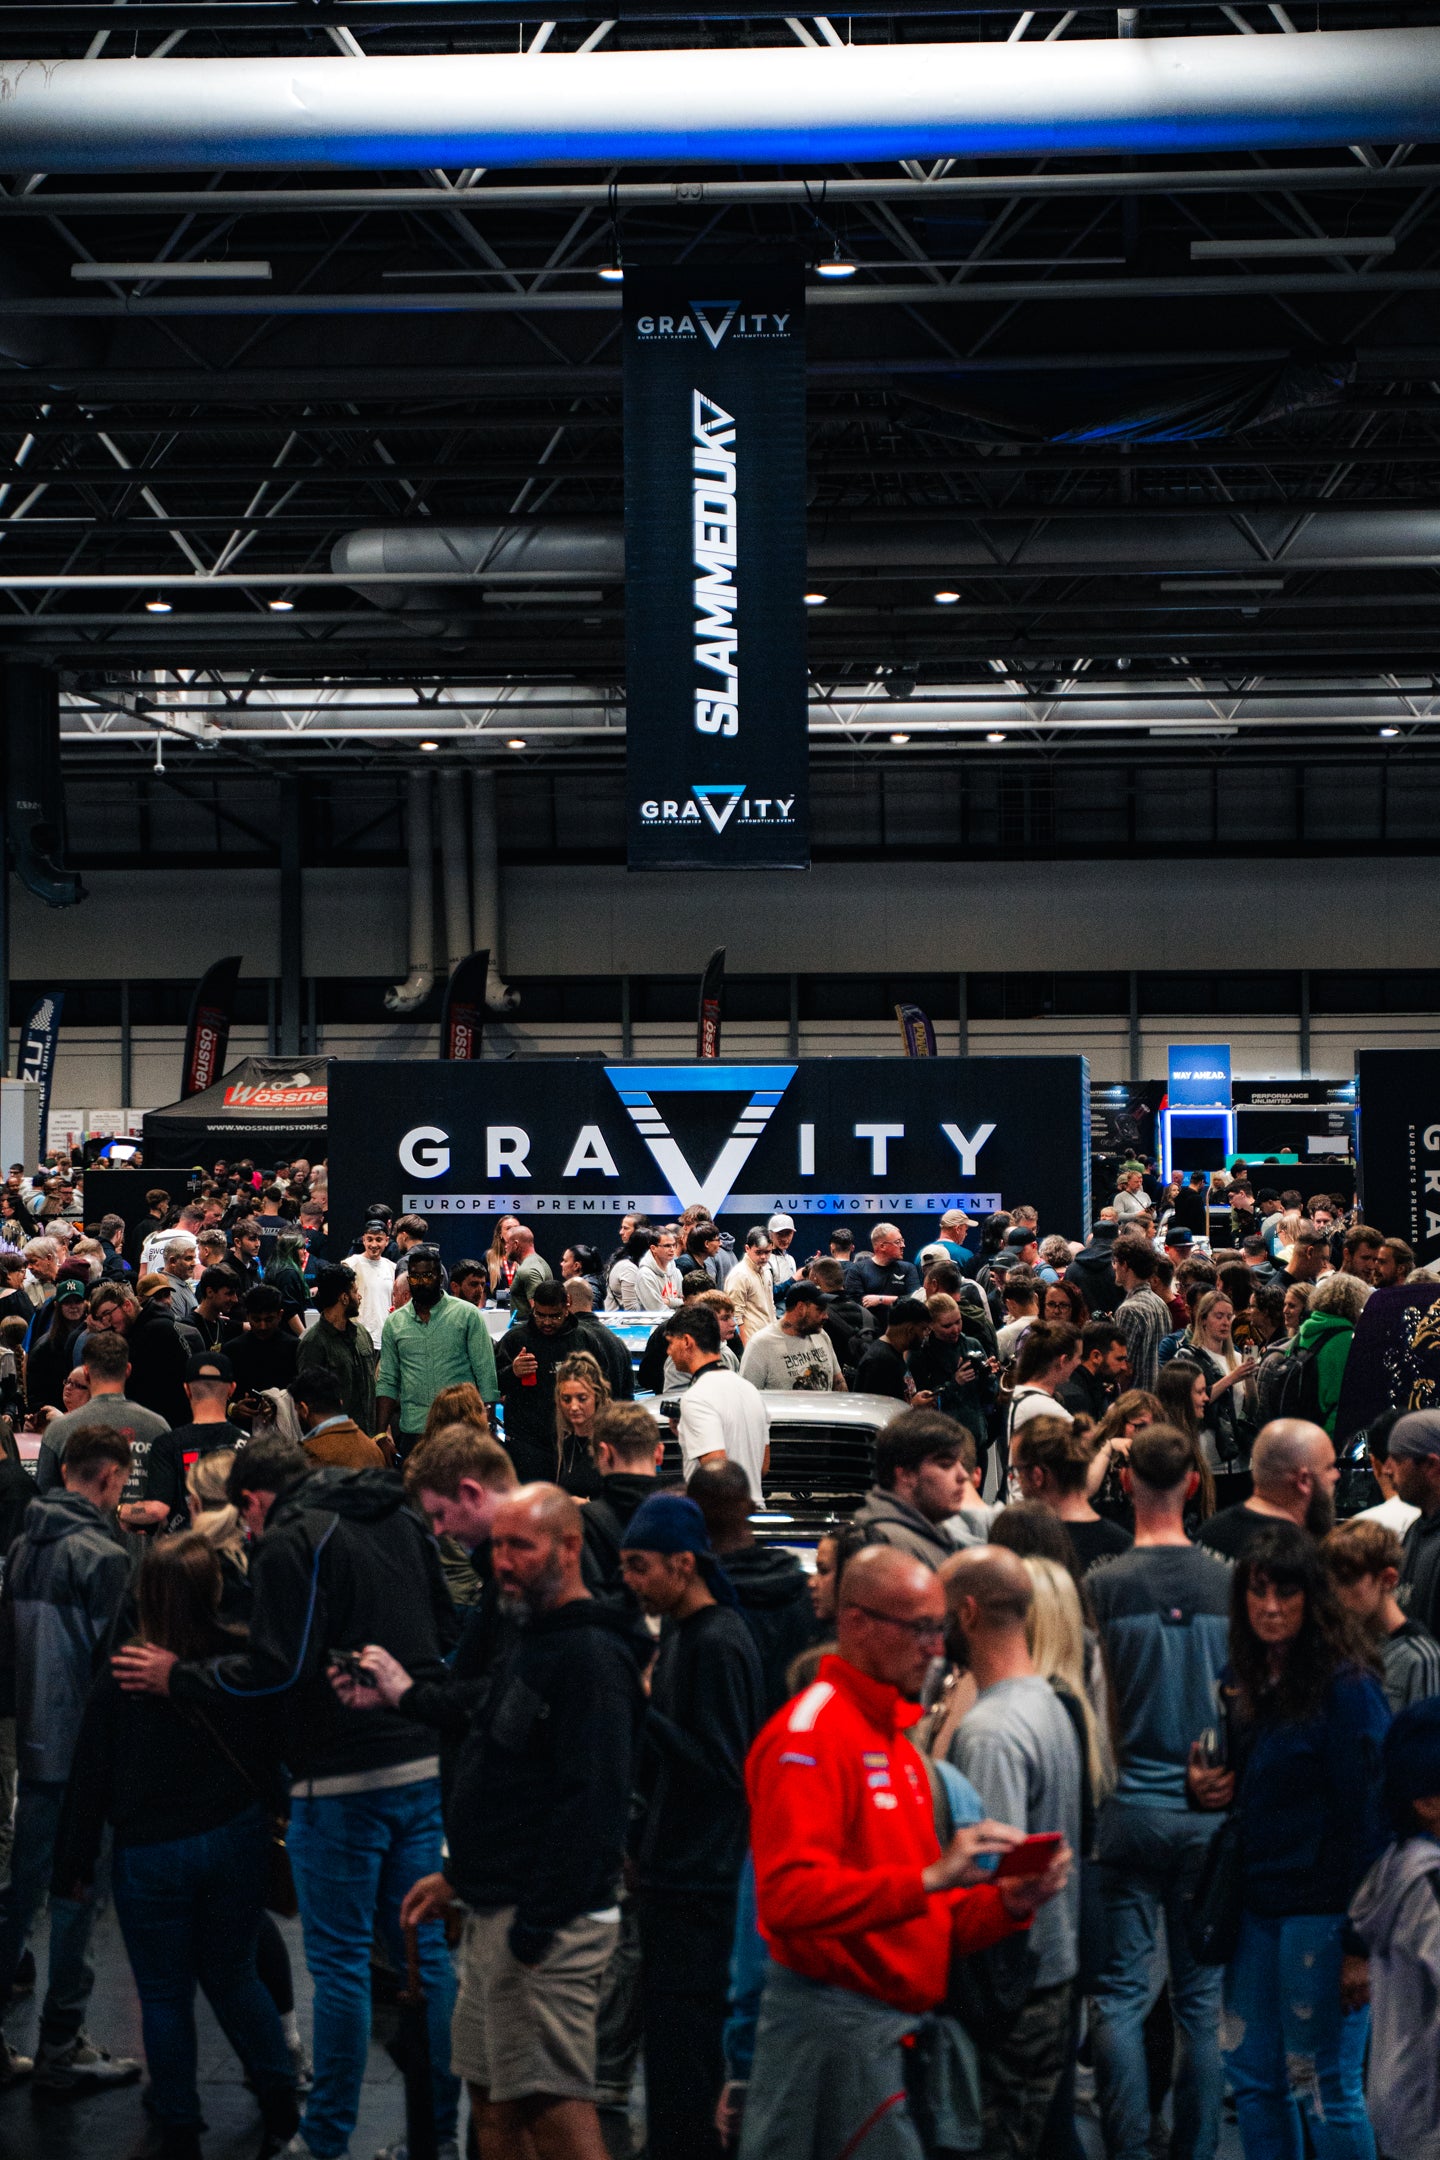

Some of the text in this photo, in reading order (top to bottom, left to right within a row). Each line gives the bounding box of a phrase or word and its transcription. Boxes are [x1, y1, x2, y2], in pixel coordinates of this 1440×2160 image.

[637, 300, 790, 349] GRAVITY
[641, 784, 795, 834] GRAVITY
[42, 1034, 52, 1076] TUNING
[1173, 1071, 1226, 1079] WAY AHEAD.
[229, 1081, 328, 1103] Wössne
[399, 1065, 997, 1220] GRAVITY
[409, 1198, 996, 1210] EUROPE'S PREMIER AUTOMOTIVE EVENT
[1408, 1124, 1418, 1243] EUROPE'S PREMIER
